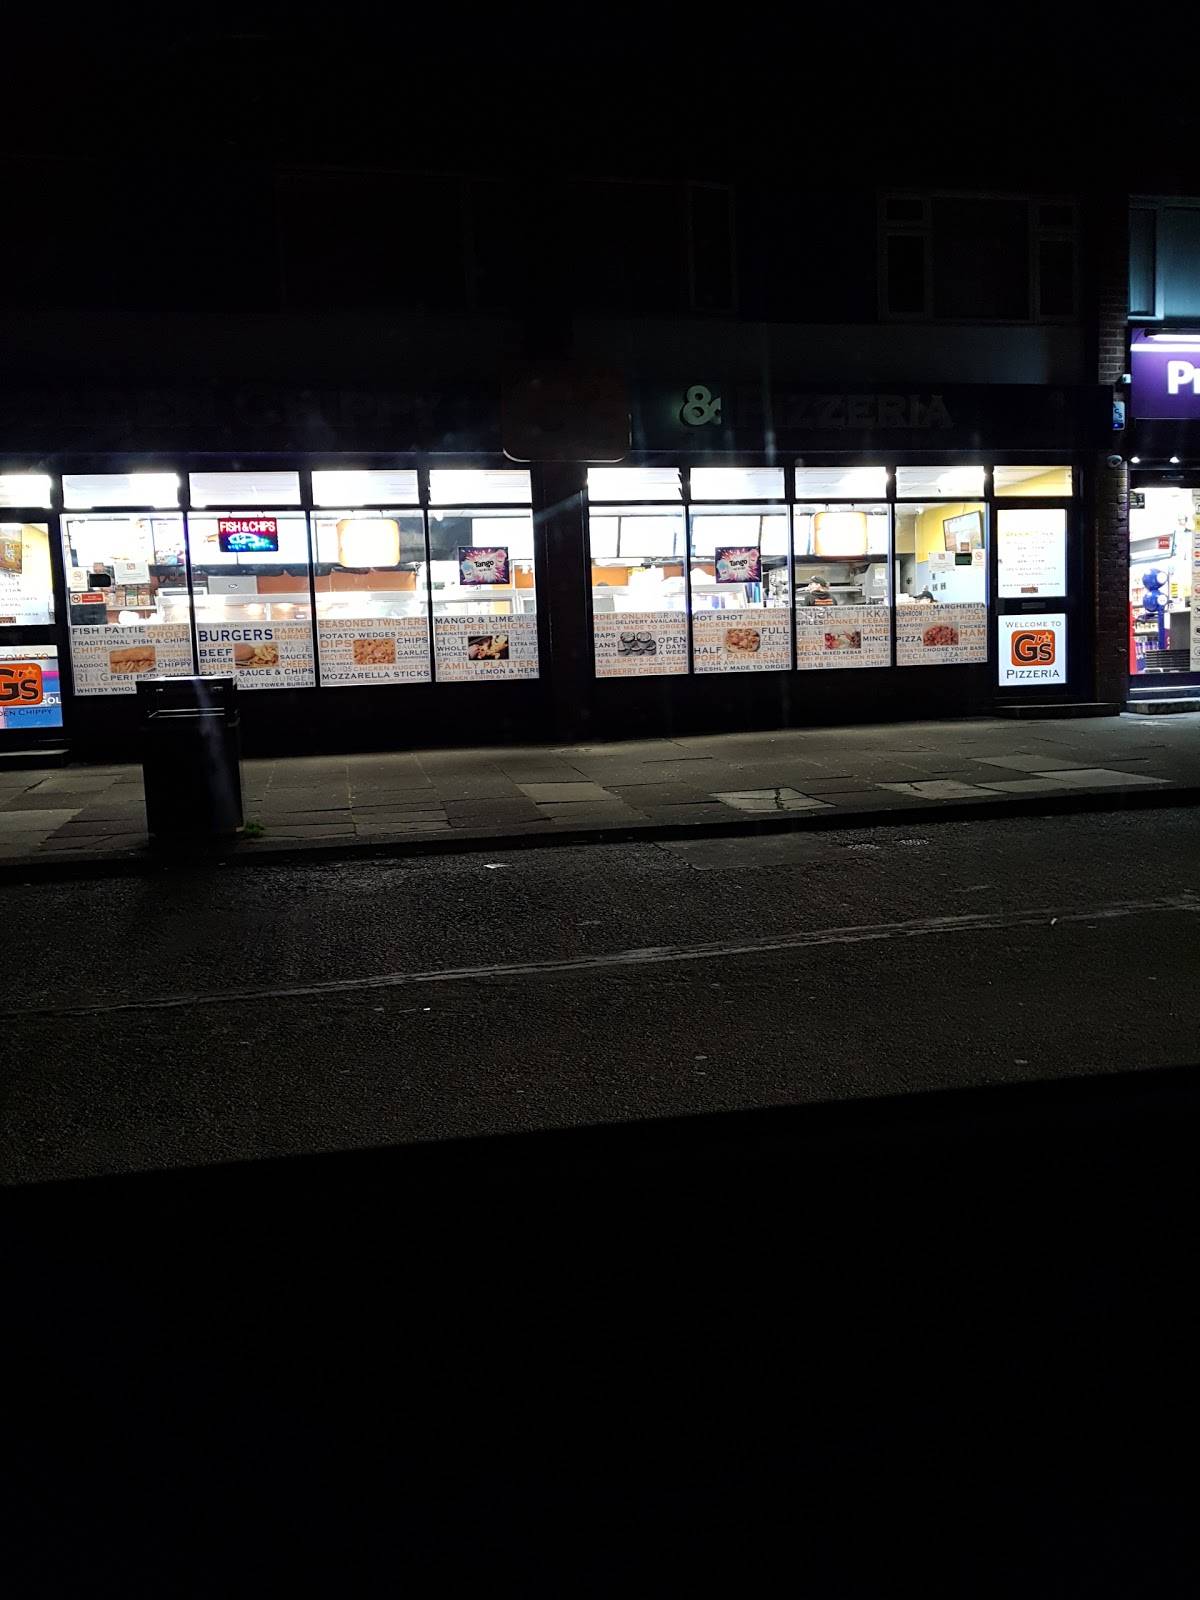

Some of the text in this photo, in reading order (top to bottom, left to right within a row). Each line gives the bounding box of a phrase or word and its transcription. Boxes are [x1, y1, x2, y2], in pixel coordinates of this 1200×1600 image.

[474, 560, 495, 568] Tango
[933, 602, 985, 610] MARGHERITA
[621, 612, 656, 620] ONLINE
[855, 609, 889, 618] TIKKA
[318, 618, 374, 629] SEASONED
[376, 616, 427, 627] TWISTERS
[435, 616, 474, 625] MANGO
[489, 615, 514, 623] LIME
[693, 619, 789, 629] CHICKEN PARMESANS
[72, 626, 145, 635] FISH PATTIE
[435, 624, 459, 632] PERI
[464, 623, 488, 631] PERI
[761, 627, 790, 635] FULL
[862, 627, 889, 635] LAMB
[199, 629, 273, 642] BURGERS
[960, 629, 986, 637] HAM
[320, 639, 352, 649] DIPS
[396, 636, 428, 644] CHIPS
[436, 636, 467, 645] HOT
[658, 636, 686, 644] OPEN
[73, 646, 107, 654] CHIPS
[199, 648, 233, 657] BEEF
[694, 646, 722, 655] HALF
[694, 652, 790, 662] PORK PARMESANS
[281, 659, 313, 668] CHEESE
[392, 663, 429, 671] NUGGETS
[437, 662, 479, 670] FAMILY
[239, 669, 272, 677] SAUCE
[284, 667, 314, 675] CHIPS
[638, 666, 666, 674] CHEESE
[1006, 669, 1060, 679] PIZZERIA
[321, 672, 391, 681] MOZZARELLA
[393, 670, 430, 678] STICKS
